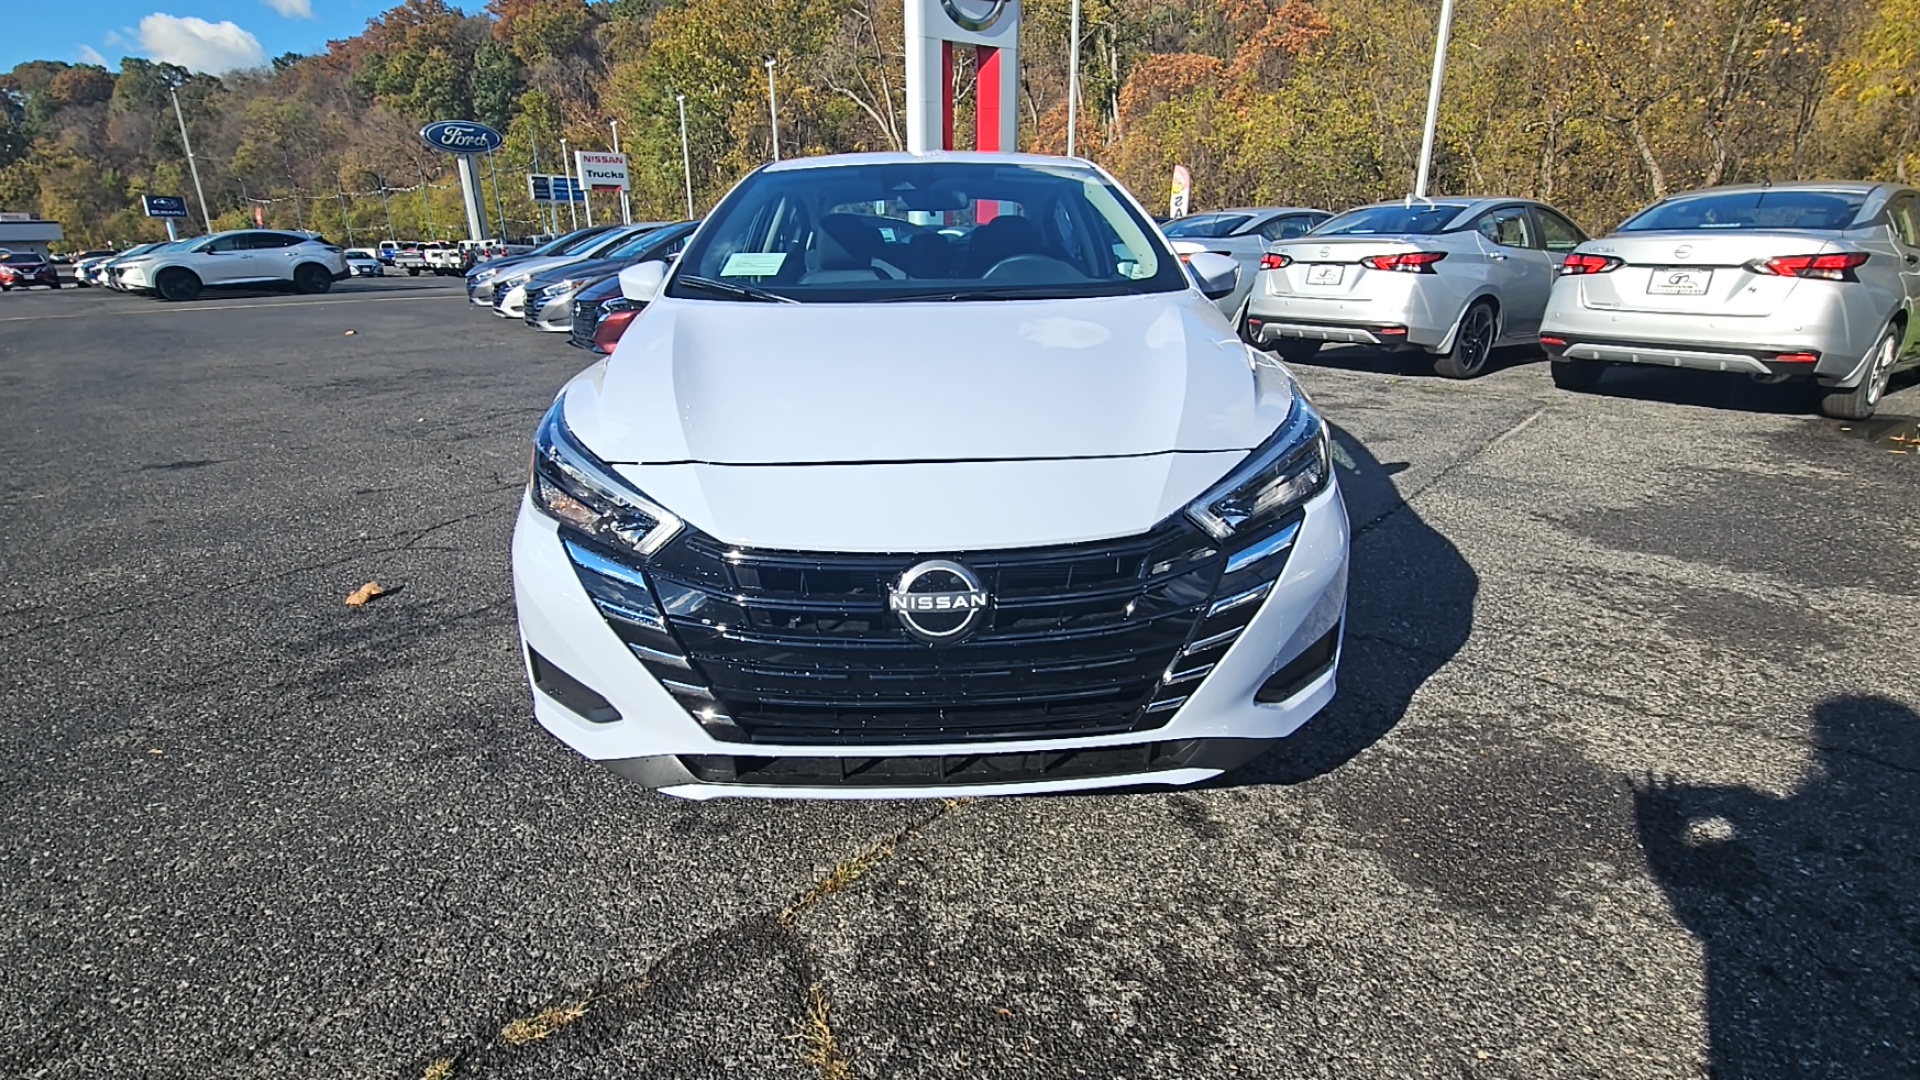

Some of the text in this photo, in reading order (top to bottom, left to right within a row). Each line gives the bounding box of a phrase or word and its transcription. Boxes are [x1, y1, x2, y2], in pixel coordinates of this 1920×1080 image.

[441, 126, 487, 146] Ford
[583, 155, 623, 164] NISSAN
[586, 170, 624, 178] Trucks
[892, 593, 986, 610] NISSAN
